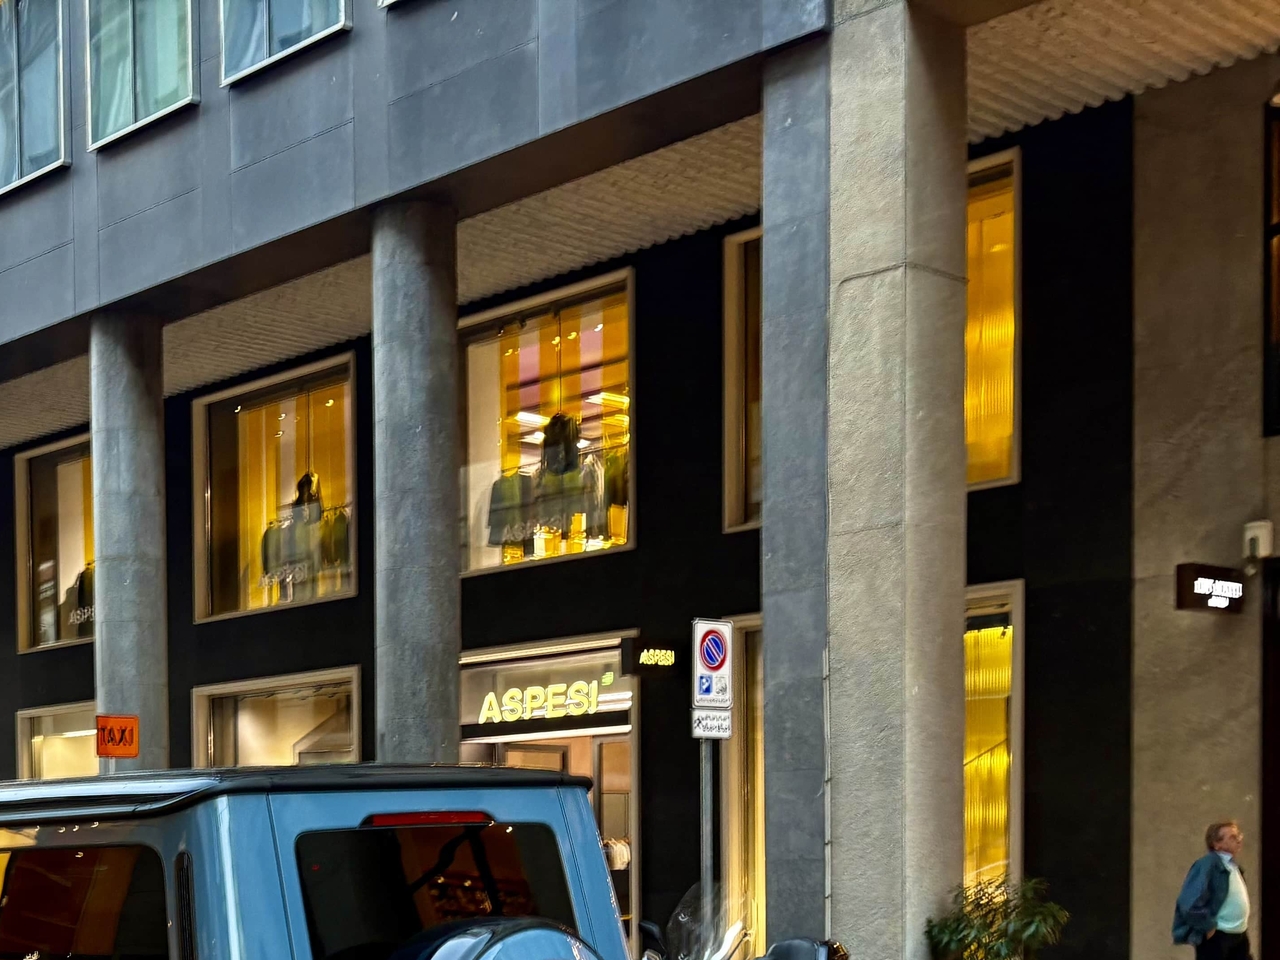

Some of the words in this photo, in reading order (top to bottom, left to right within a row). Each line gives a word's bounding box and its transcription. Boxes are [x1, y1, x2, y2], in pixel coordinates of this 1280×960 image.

[639, 649, 675, 666] ASPESI
[478, 679, 599, 724] ASPESI
[98, 726, 134, 746] TAXI
